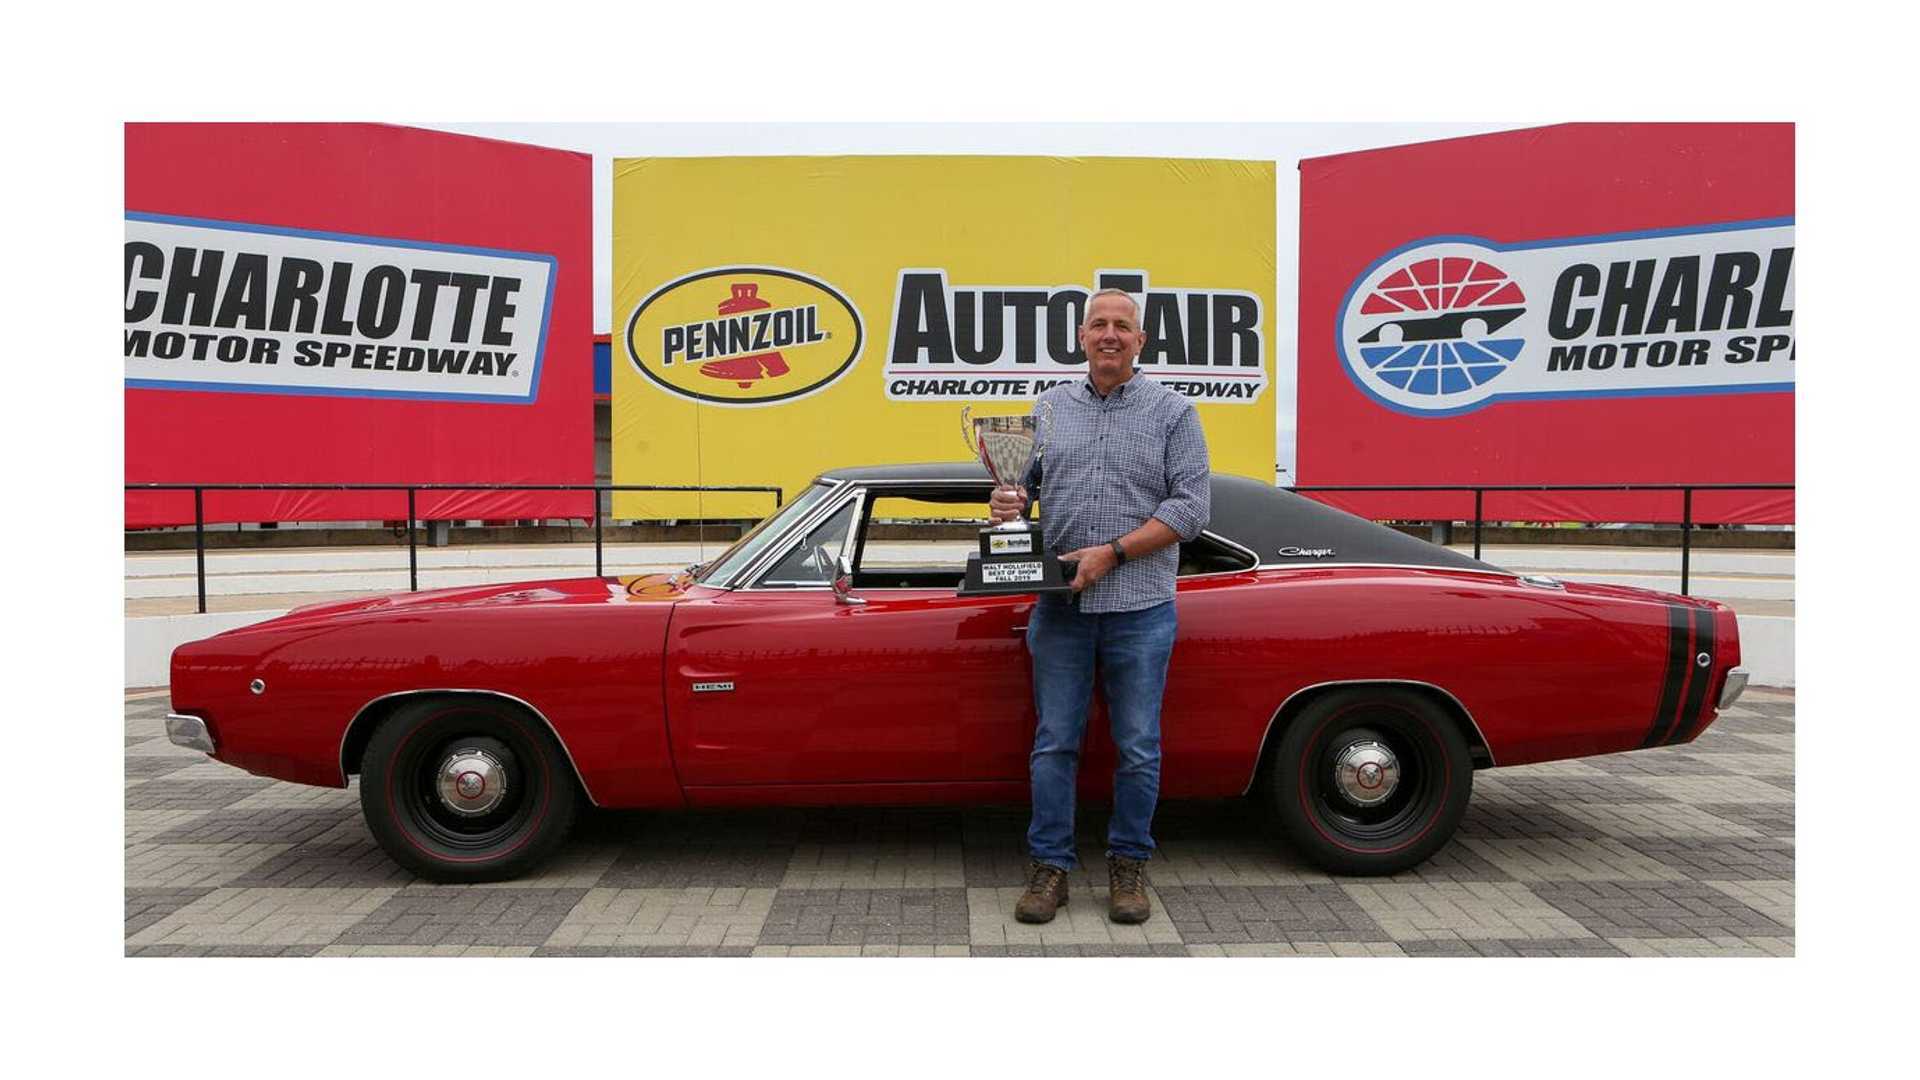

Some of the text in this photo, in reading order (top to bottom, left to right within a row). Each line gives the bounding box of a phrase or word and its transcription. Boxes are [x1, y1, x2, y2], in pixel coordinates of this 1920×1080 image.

[124, 241, 521, 346] CHARLOTTE
[892, 273, 1260, 367] AUTOAIR
[1548, 247, 1795, 342] CHARL
[124, 329, 518, 377] MOTOR SPEEDWAY
[664, 306, 823, 364] PENNZOIL
[1547, 334, 1796, 372] MOTOR SP
[890, 380, 1029, 395] CHARLOTTE
[1278, 546, 1335, 558] Charger
